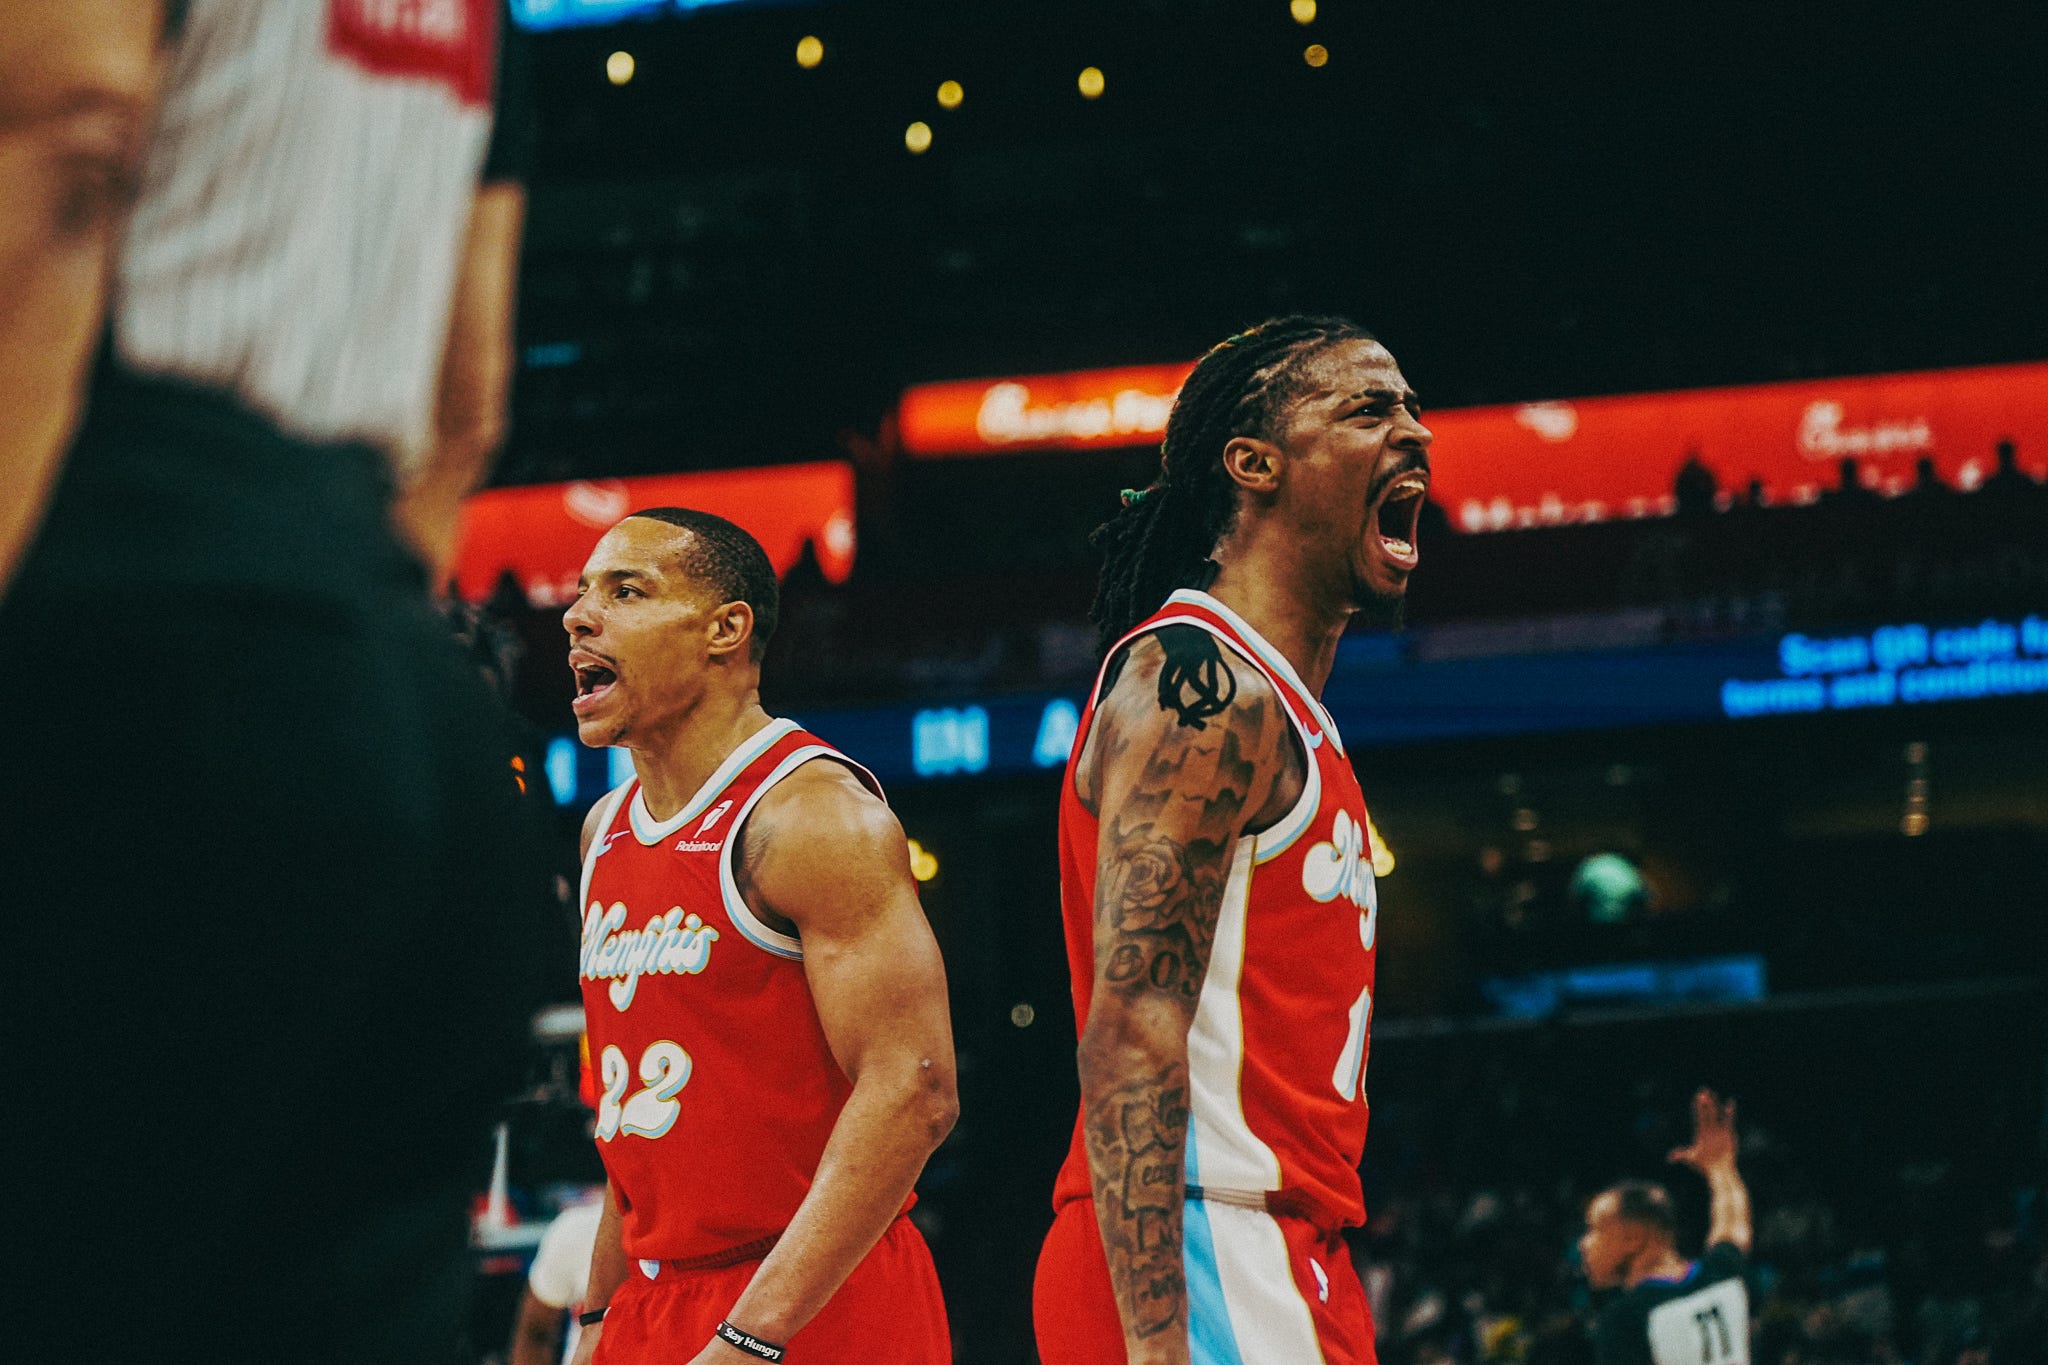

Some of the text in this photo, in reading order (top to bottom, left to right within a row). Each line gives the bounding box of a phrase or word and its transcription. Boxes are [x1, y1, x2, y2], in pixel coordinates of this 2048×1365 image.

[675, 840, 723, 852] Robinhood
[580, 901, 720, 1013] Memphis
[594, 1039, 693, 1143] 22
[724, 1327, 781, 1360] Stay Hungry
